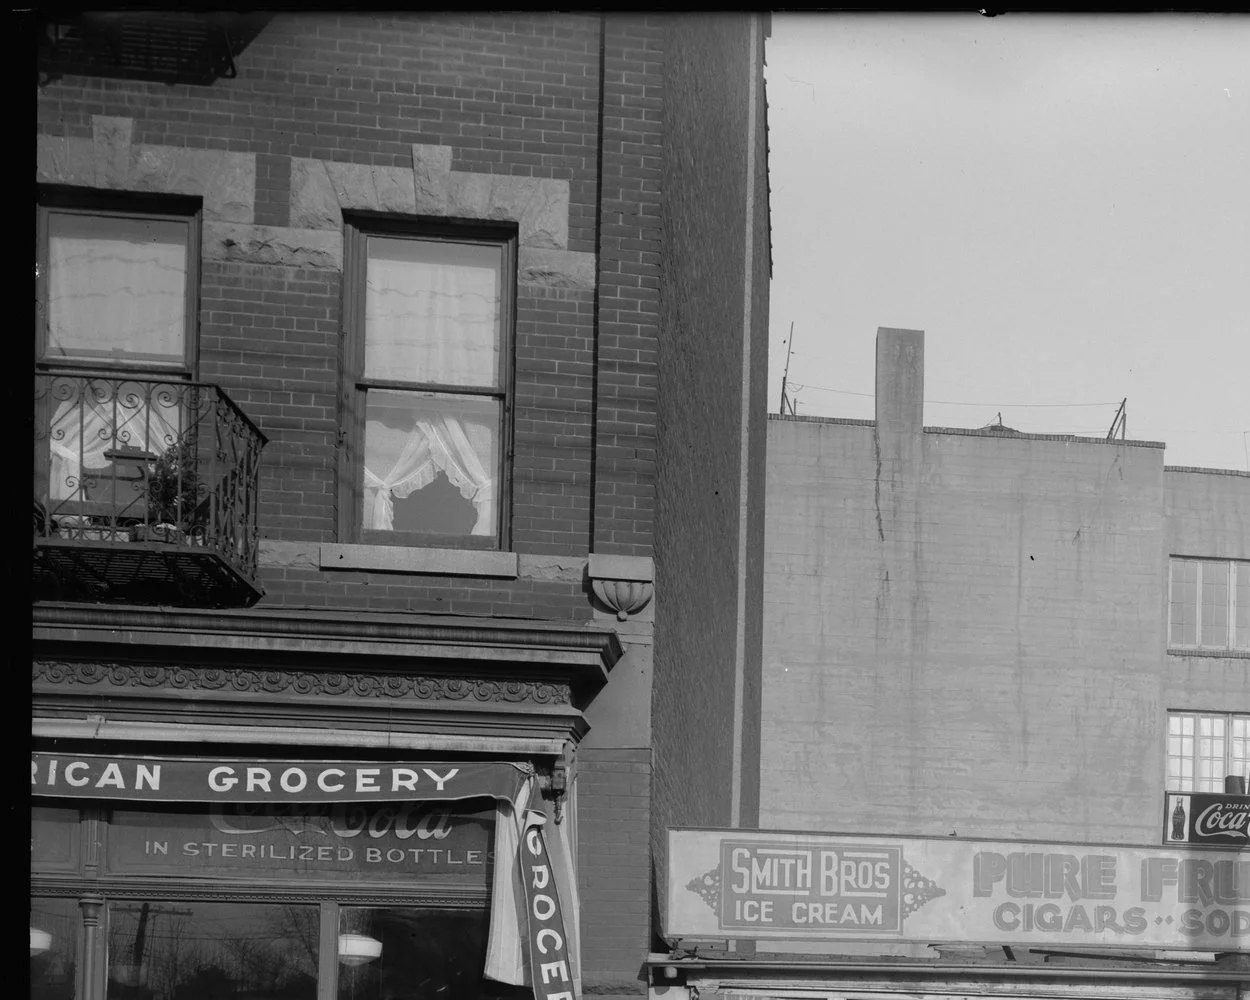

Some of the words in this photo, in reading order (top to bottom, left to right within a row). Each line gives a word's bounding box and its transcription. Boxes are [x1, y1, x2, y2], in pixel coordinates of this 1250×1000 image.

[31, 758, 162, 791] ICAN
[207, 766, 460, 793] GROCERY
[145, 841, 169, 855] IN
[183, 842, 354, 862] STERILIZED
[731, 848, 812, 896] SMITH
[820, 850, 890, 898] BROS
[972, 851, 1118, 902] PURE
[735, 900, 774, 922] ICE
[791, 902, 883, 925] CREAM
[992, 901, 1149, 935] CIGARS
